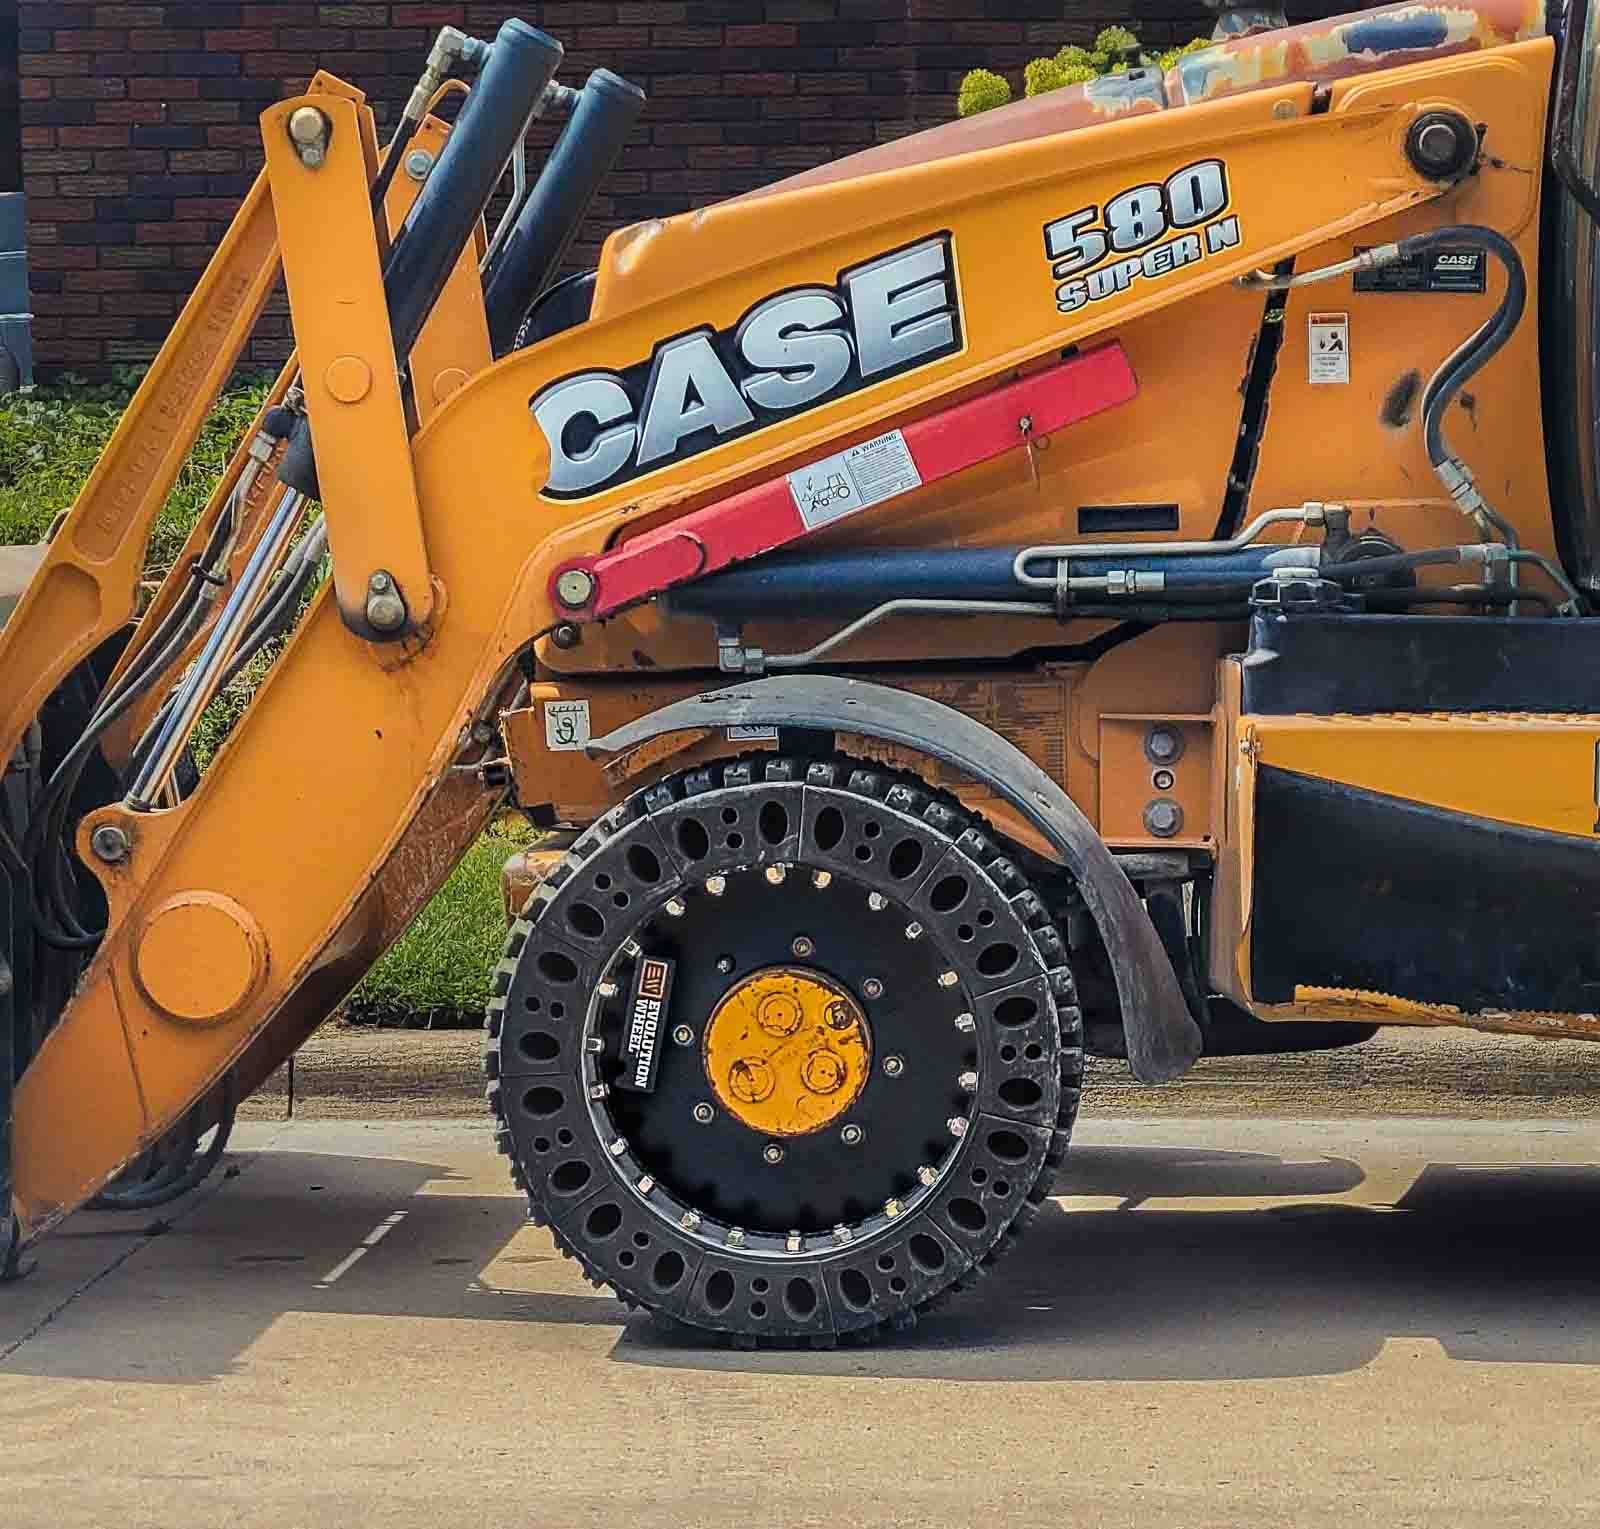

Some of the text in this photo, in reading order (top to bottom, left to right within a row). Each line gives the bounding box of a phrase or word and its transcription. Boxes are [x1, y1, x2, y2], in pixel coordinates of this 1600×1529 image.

[1045, 160, 1227, 278] 580
[1056, 214, 1239, 312] SUPER N
[1438, 255, 1478, 264] CASE
[530, 232, 959, 496] CASE
[861, 432, 898, 453] WARNING
[628, 999, 649, 1054] WHEEL
[634, 999, 661, 1089] EVOLUTION
